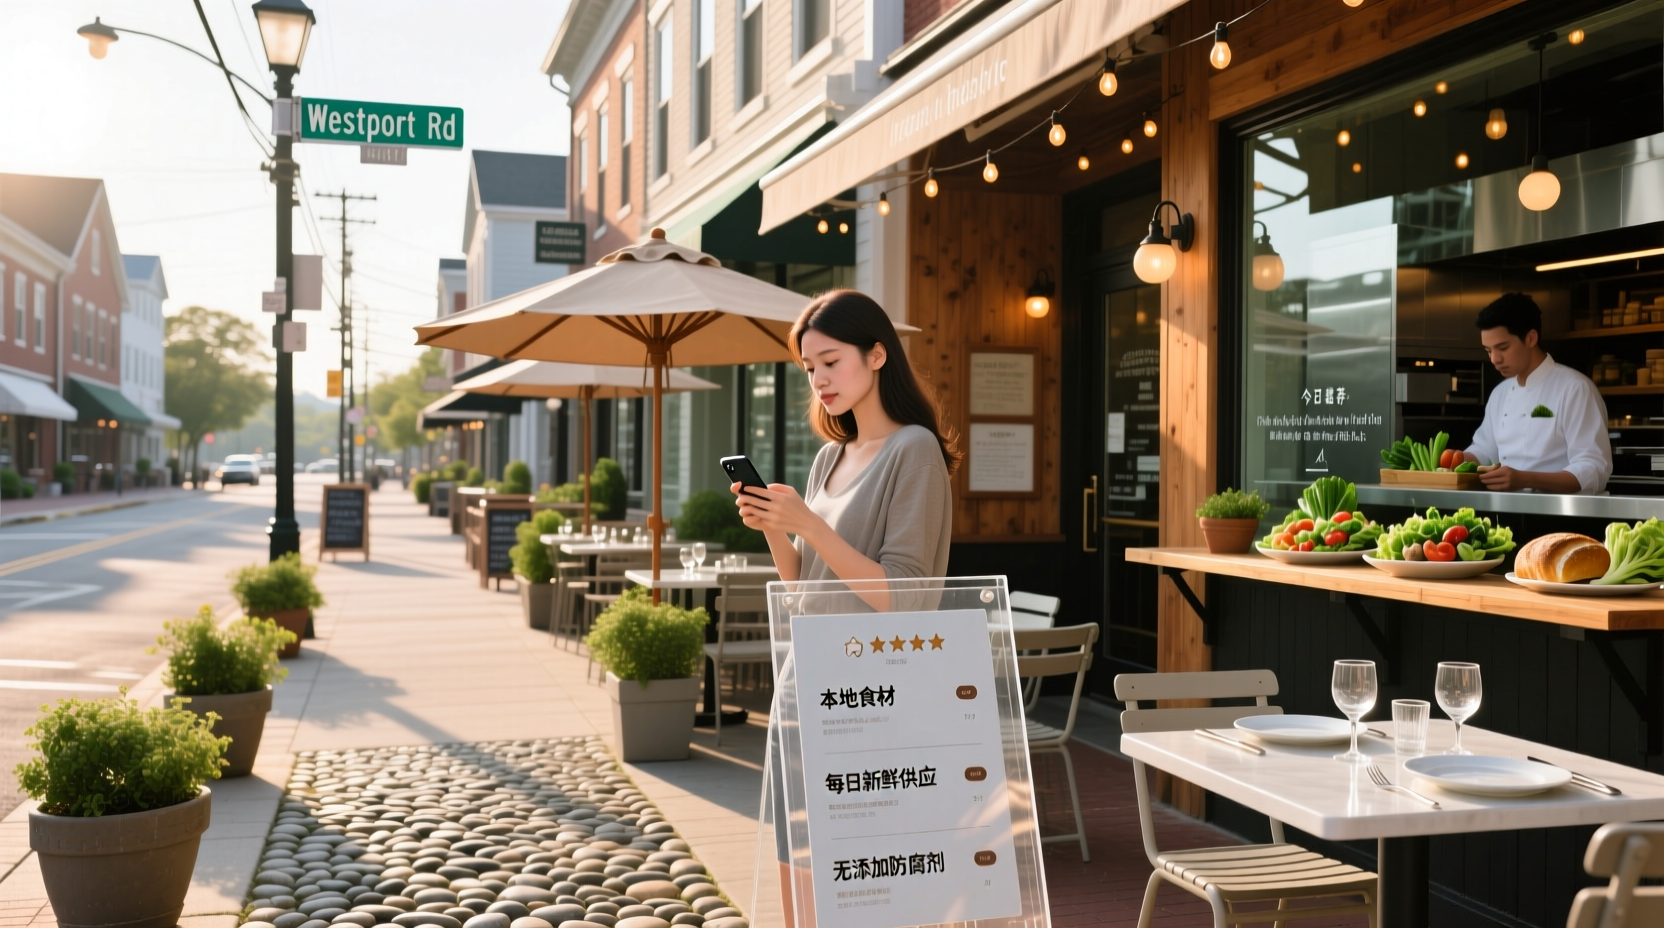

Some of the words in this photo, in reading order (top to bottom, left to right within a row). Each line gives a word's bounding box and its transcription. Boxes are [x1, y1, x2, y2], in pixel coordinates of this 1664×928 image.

[308, 103, 416, 143] Westport
[428, 112, 456, 141] Rd
[820, 685, 896, 710] 本地食材
[825, 765, 937, 794] 每日新鲜供应
